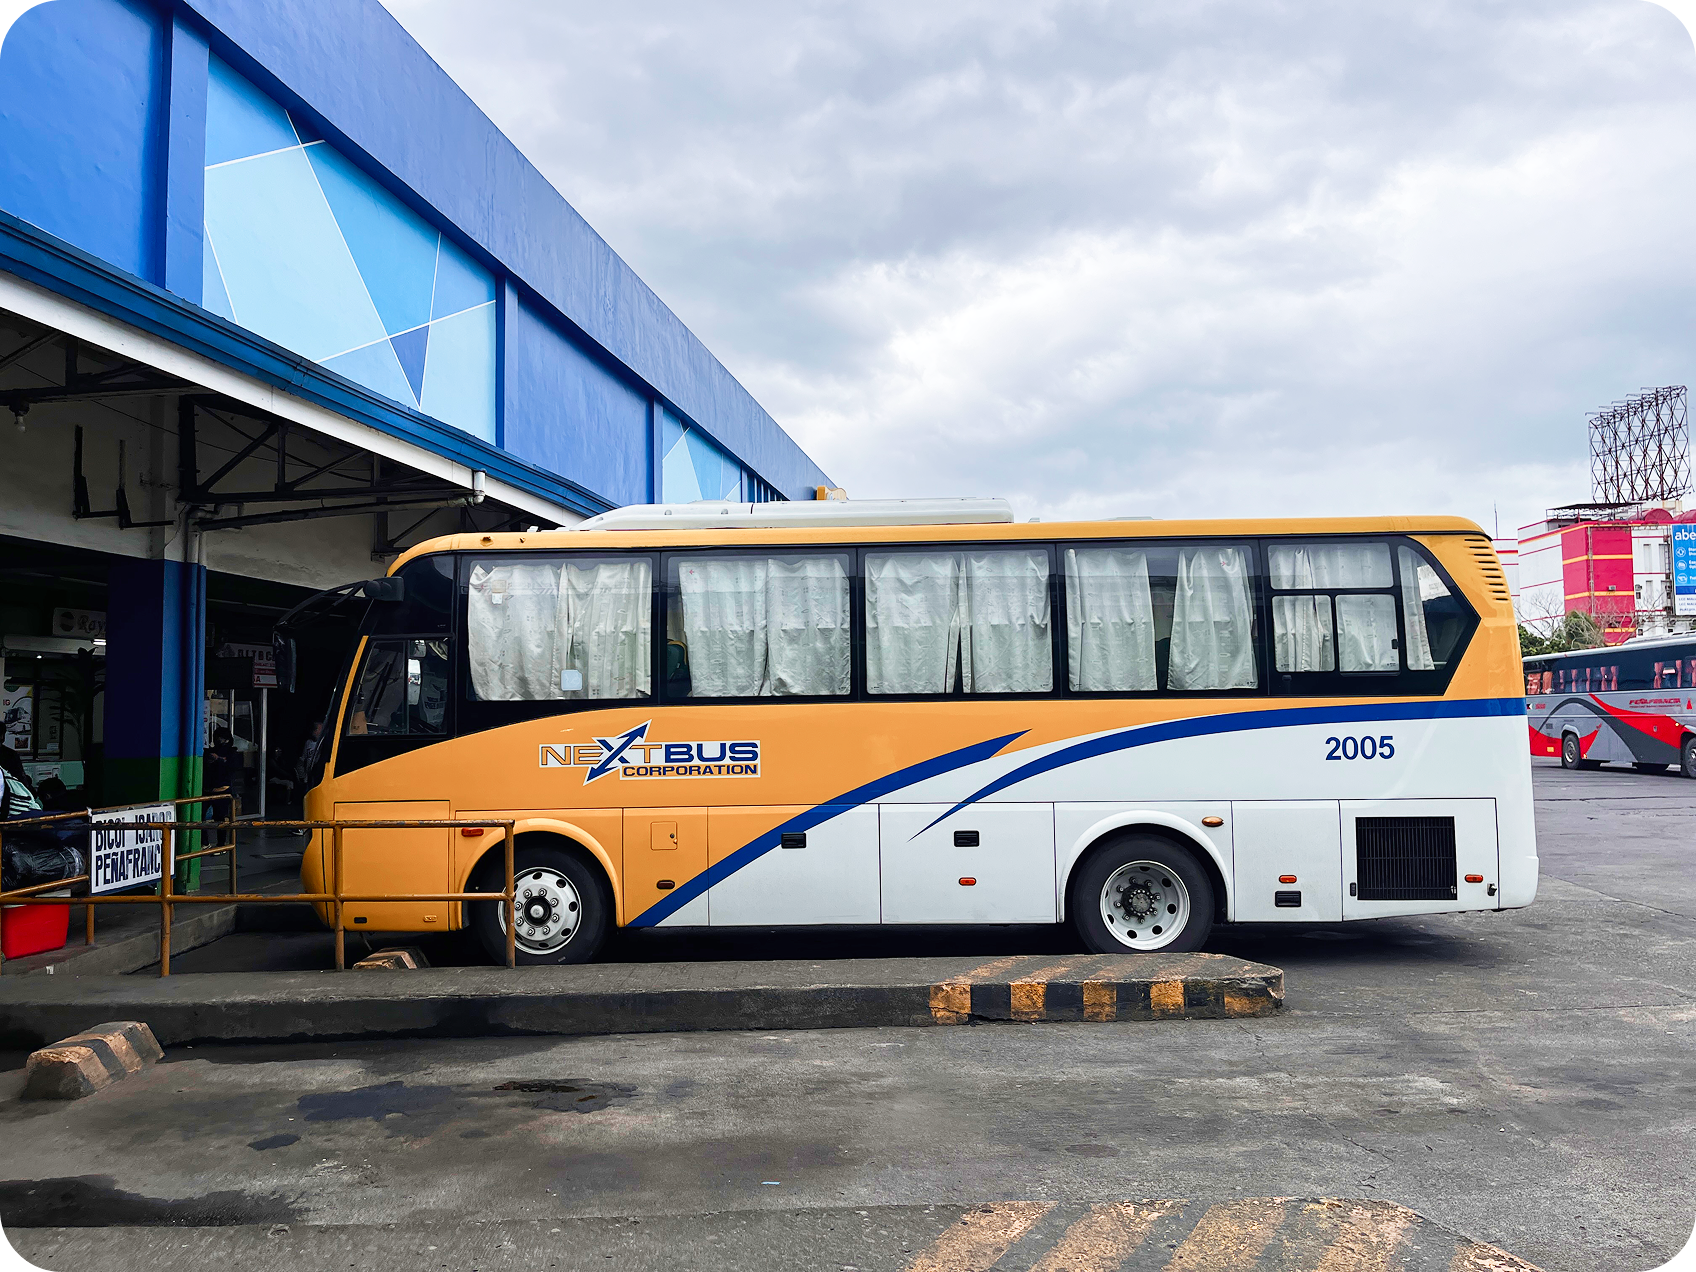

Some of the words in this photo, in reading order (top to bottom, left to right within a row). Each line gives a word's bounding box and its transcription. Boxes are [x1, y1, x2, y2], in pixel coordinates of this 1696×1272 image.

[1325, 735, 1395, 760] 2005
[623, 764, 757, 777] CORPORATION
[95, 843, 162, 887] PEÑAFRANC
